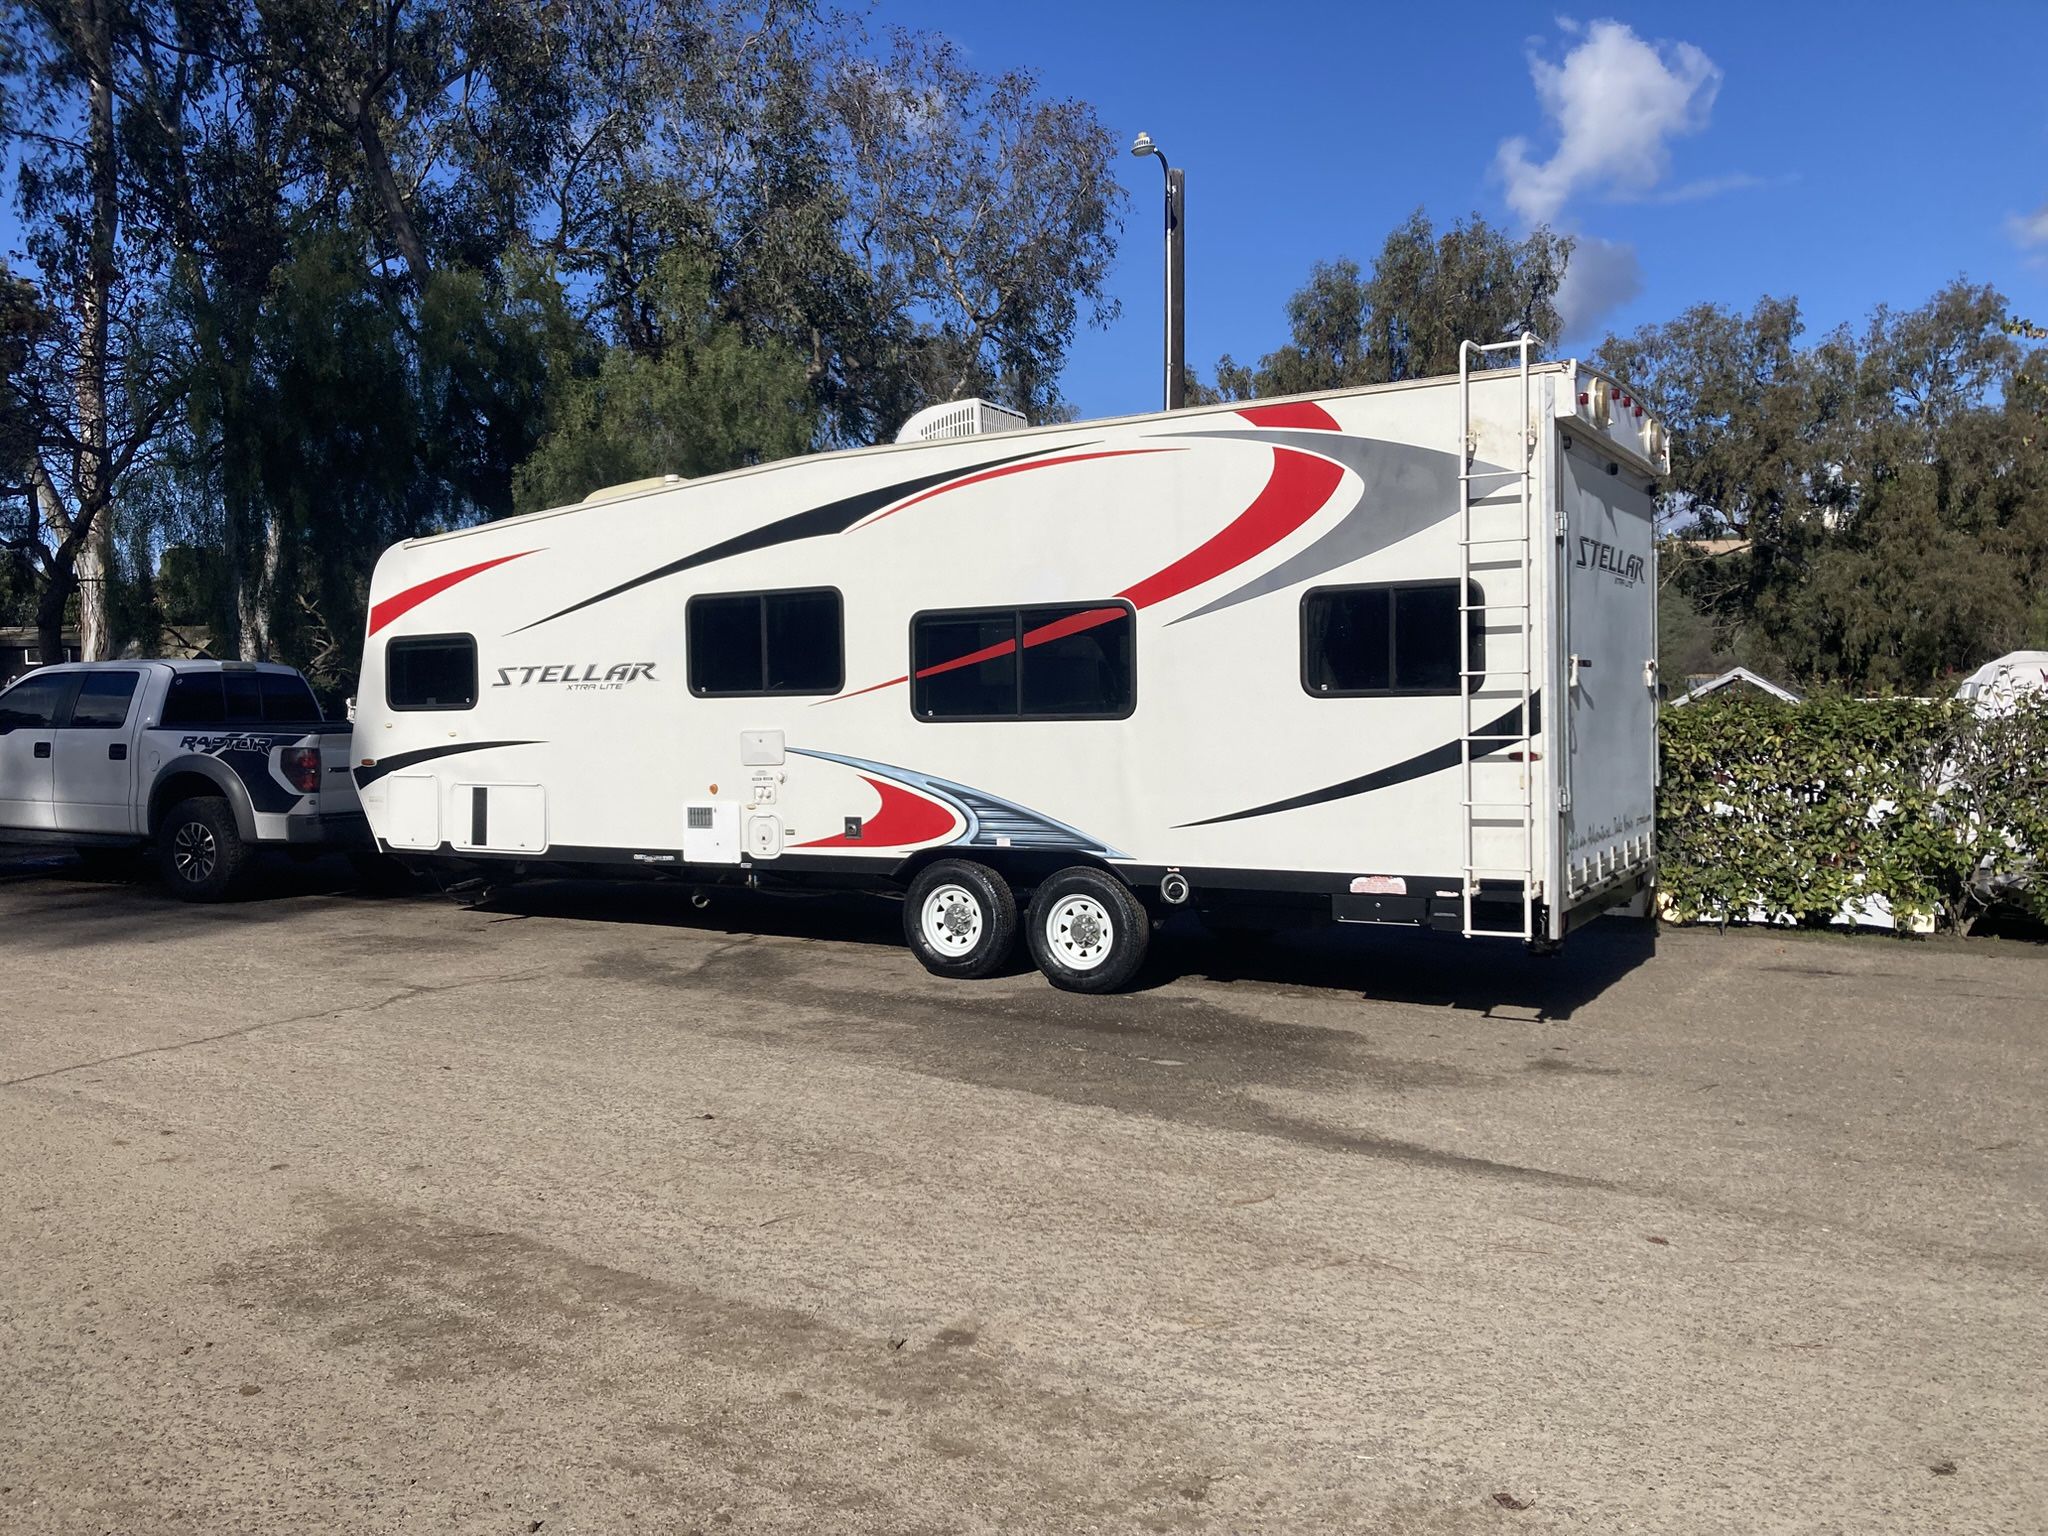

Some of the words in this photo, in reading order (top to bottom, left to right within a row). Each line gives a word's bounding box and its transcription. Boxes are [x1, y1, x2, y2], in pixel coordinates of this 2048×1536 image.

[1576, 535, 1645, 584] STELLAR
[491, 661, 660, 687] STELLAR
[179, 735, 273, 756] RAPTOR
